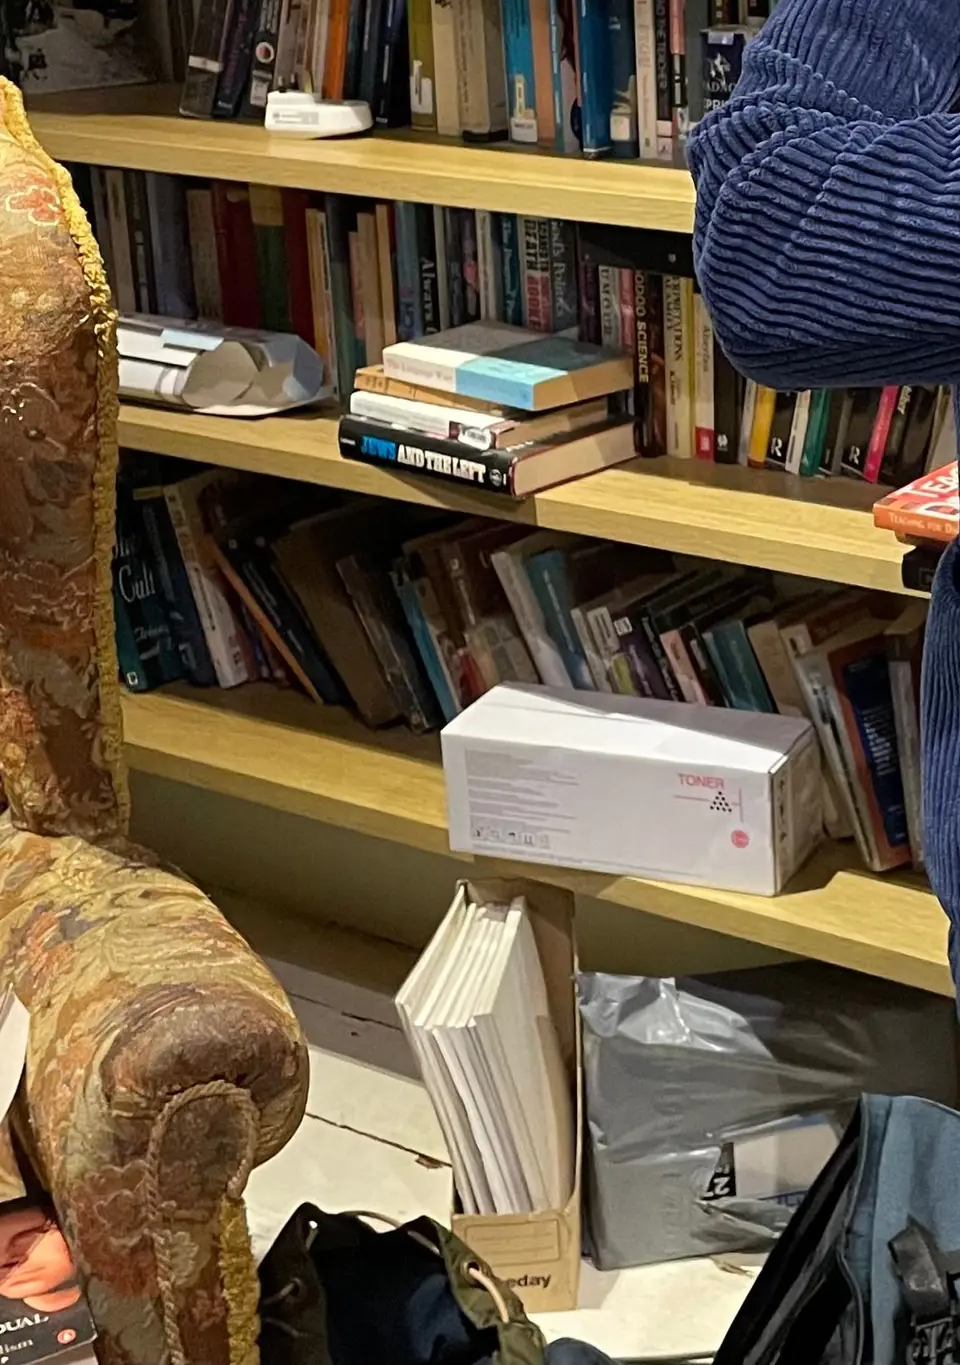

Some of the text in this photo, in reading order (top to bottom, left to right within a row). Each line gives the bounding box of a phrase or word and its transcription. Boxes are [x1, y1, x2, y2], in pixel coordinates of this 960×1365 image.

[523, 218, 539, 273] DEATH
[421, 257, 437, 317] Always
[635, 320, 650, 383] SCIENCE
[360, 435, 486, 483] JEWS AND THE LEFT
[677, 773, 725, 789] TONER
